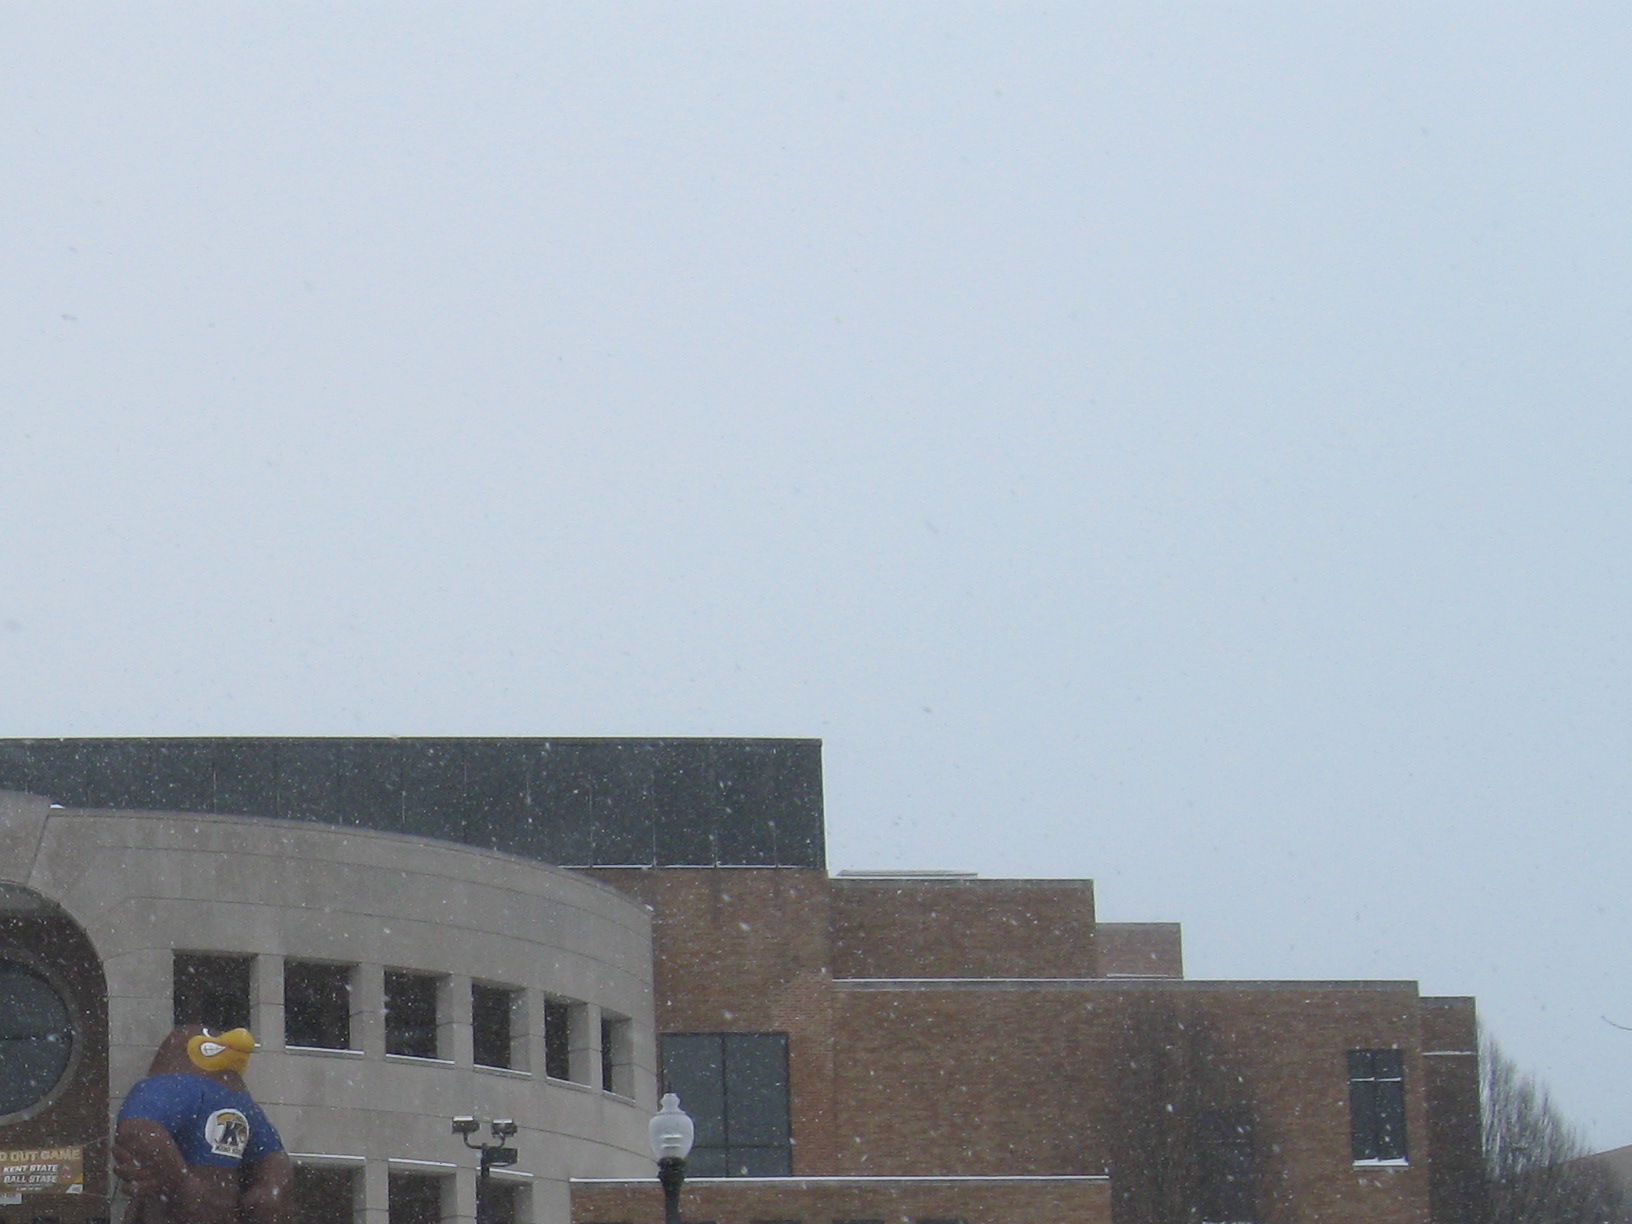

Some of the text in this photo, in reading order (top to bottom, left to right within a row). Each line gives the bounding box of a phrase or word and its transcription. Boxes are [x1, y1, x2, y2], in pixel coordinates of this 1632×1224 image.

[10, 1150, 38, 1162] OUT
[40, 1148, 81, 1161] GAME
[3, 1164, 59, 1173] KENT STATE
[3, 1174, 58, 1184] BALL STATE
